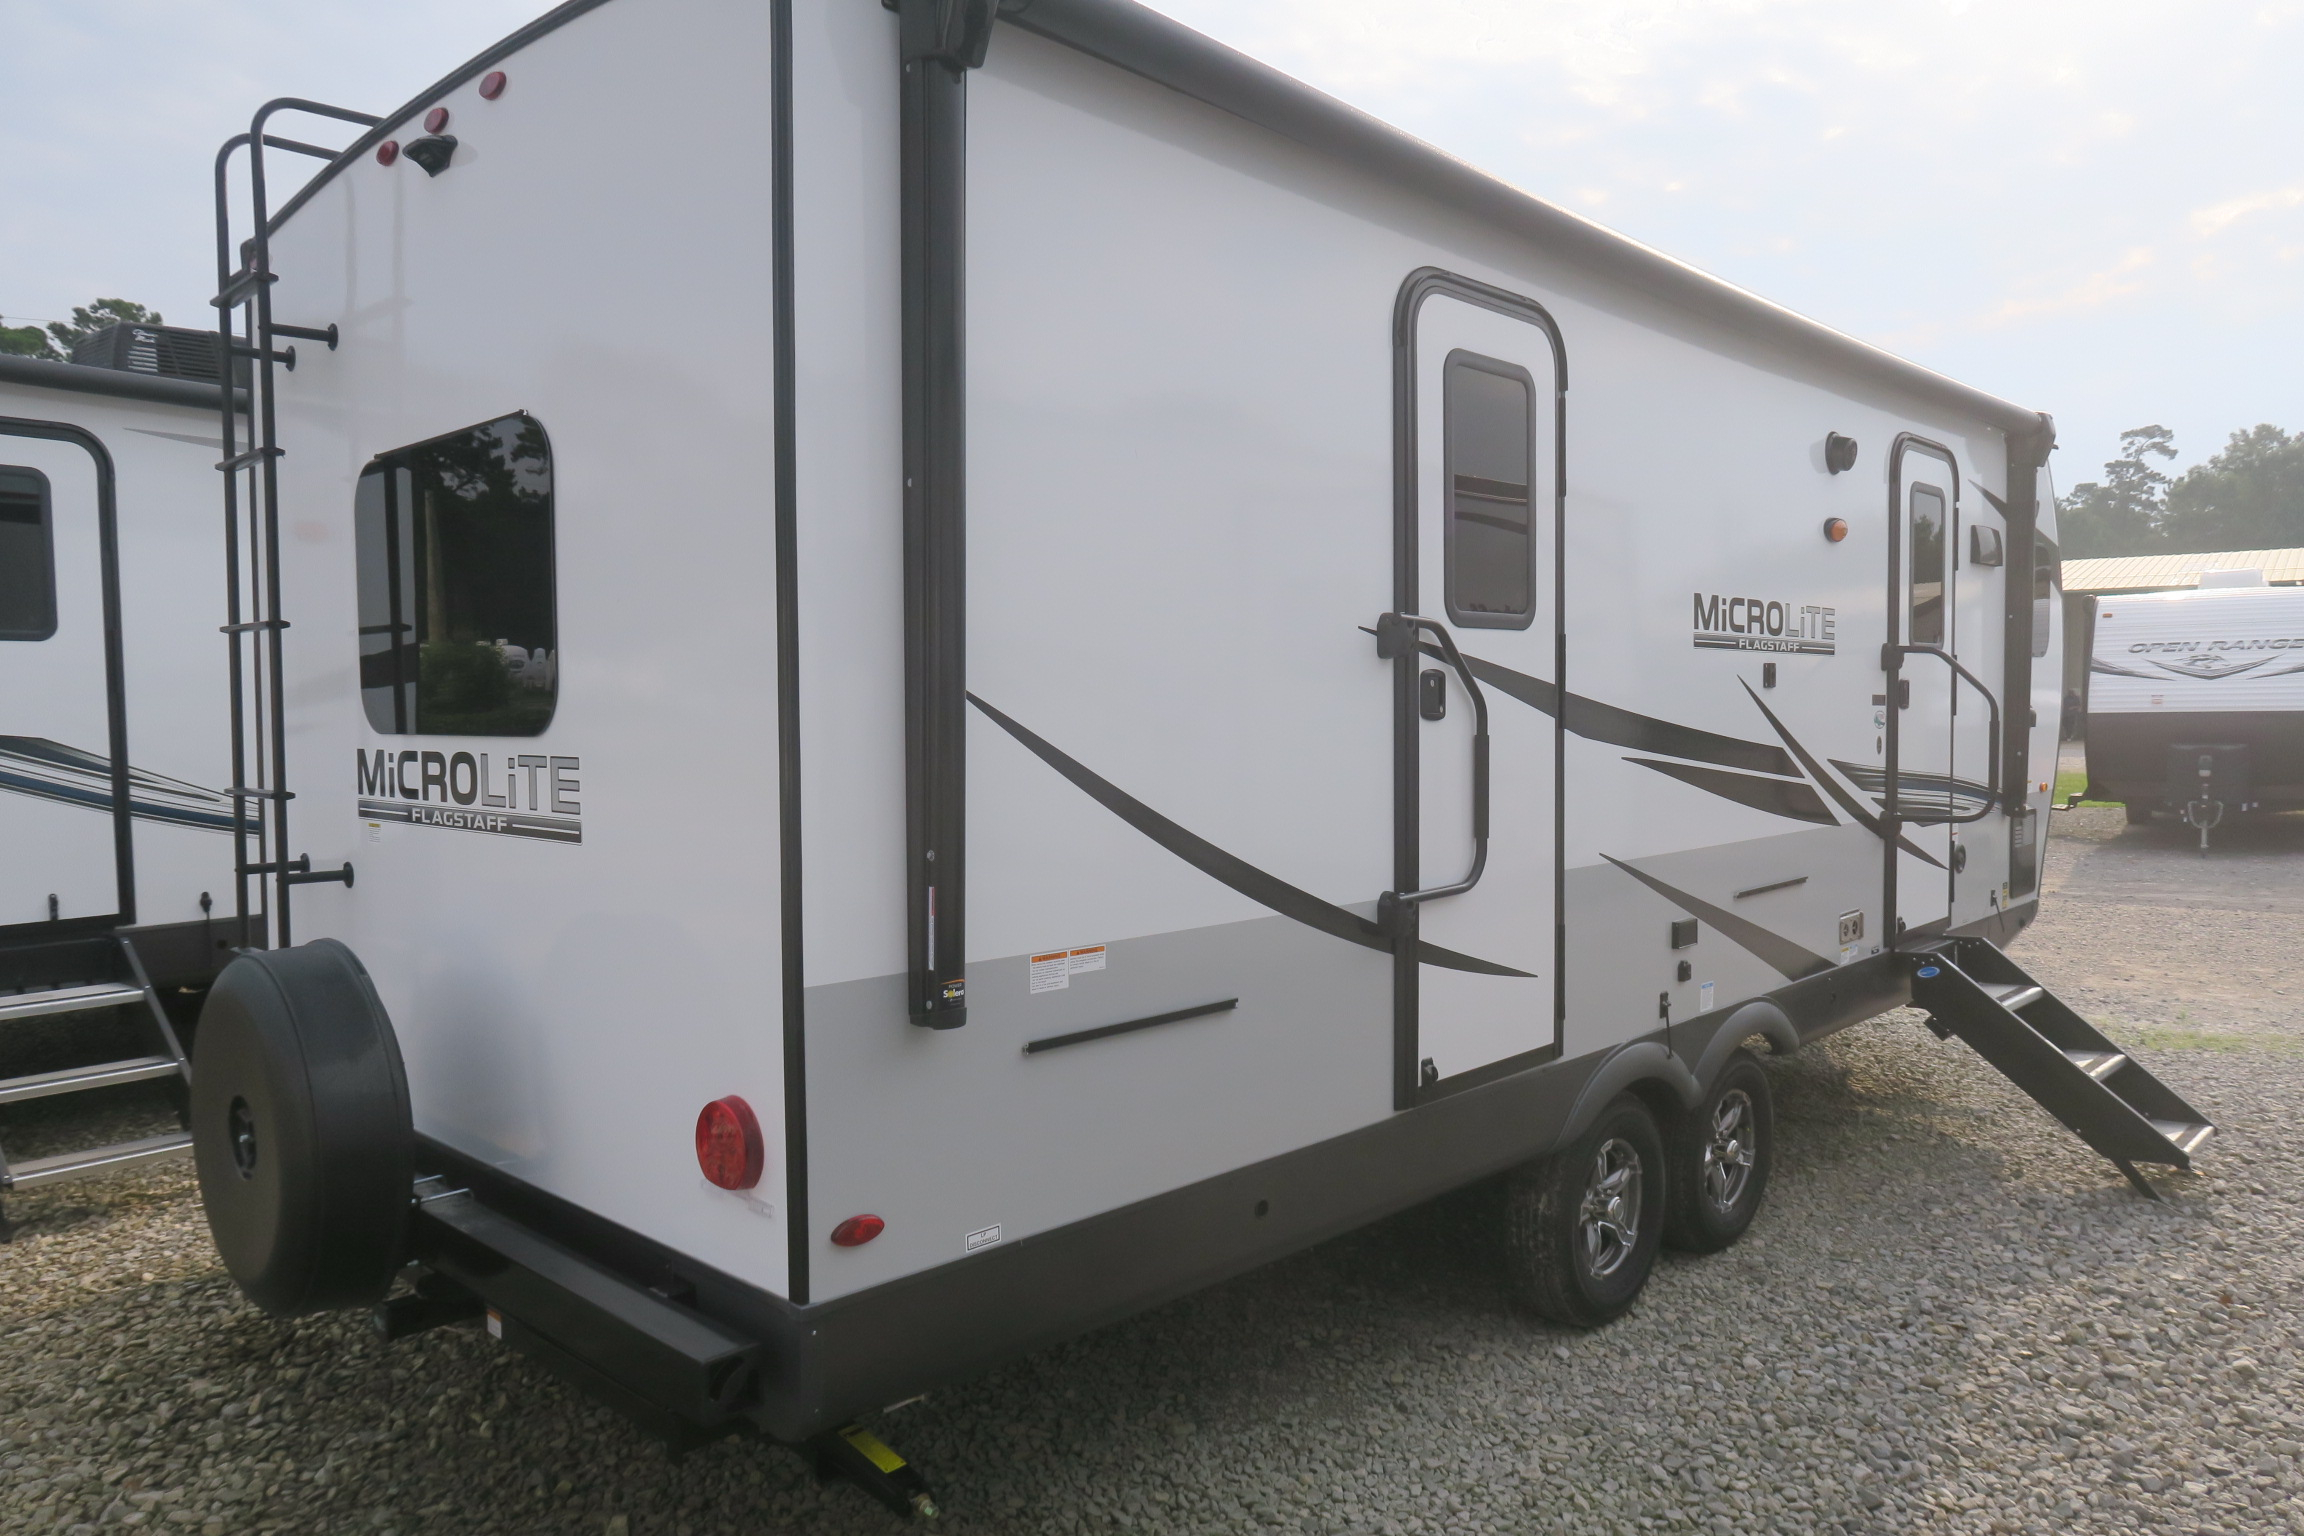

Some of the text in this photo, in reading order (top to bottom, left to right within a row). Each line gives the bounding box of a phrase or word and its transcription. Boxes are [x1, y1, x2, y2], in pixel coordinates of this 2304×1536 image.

[1694, 593, 1835, 640] MiCROLiTE
[1739, 639, 1799, 652] FLAGSTAFF
[2128, 638, 2304, 653] OPEN RANGE
[357, 748, 580, 815] MiCROLiTE
[411, 808, 508, 832] FLAGSTAFF
